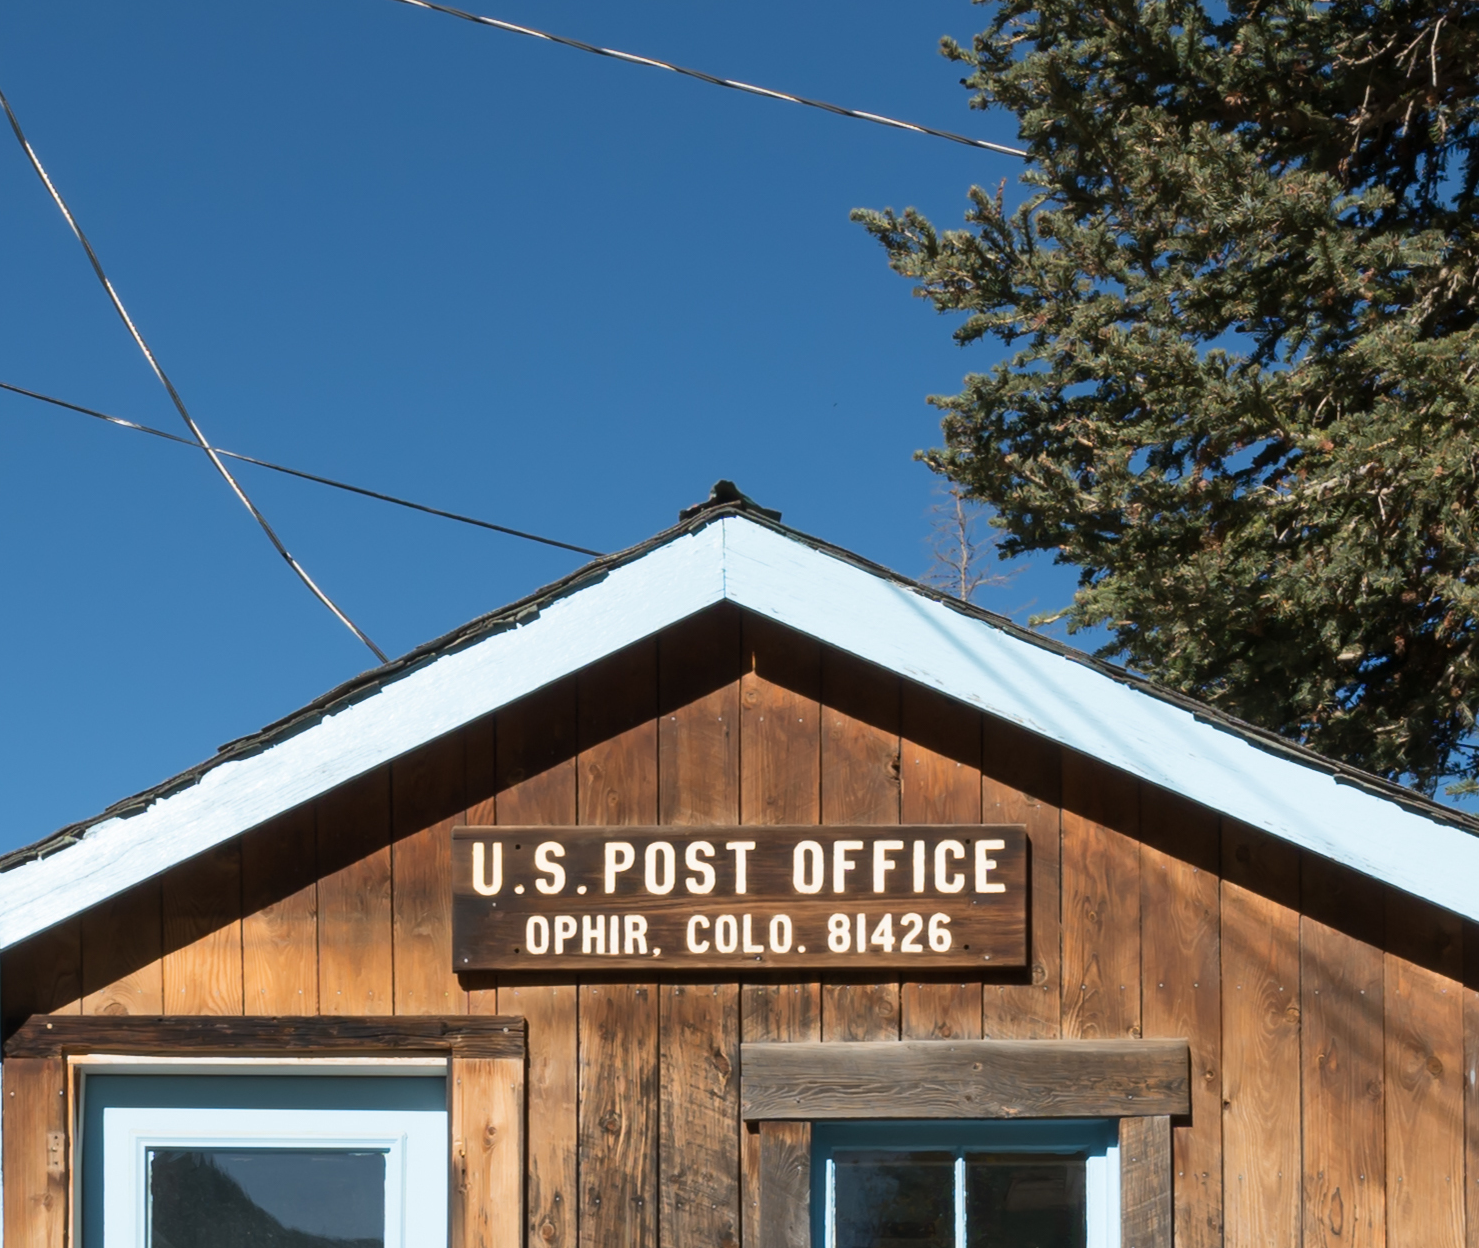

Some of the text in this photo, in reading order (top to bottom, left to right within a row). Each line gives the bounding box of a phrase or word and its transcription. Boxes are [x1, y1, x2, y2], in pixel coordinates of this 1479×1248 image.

[792, 838, 1007, 895] OFFICE
[525, 912, 953, 958] OPHIR, COLO. 81426
